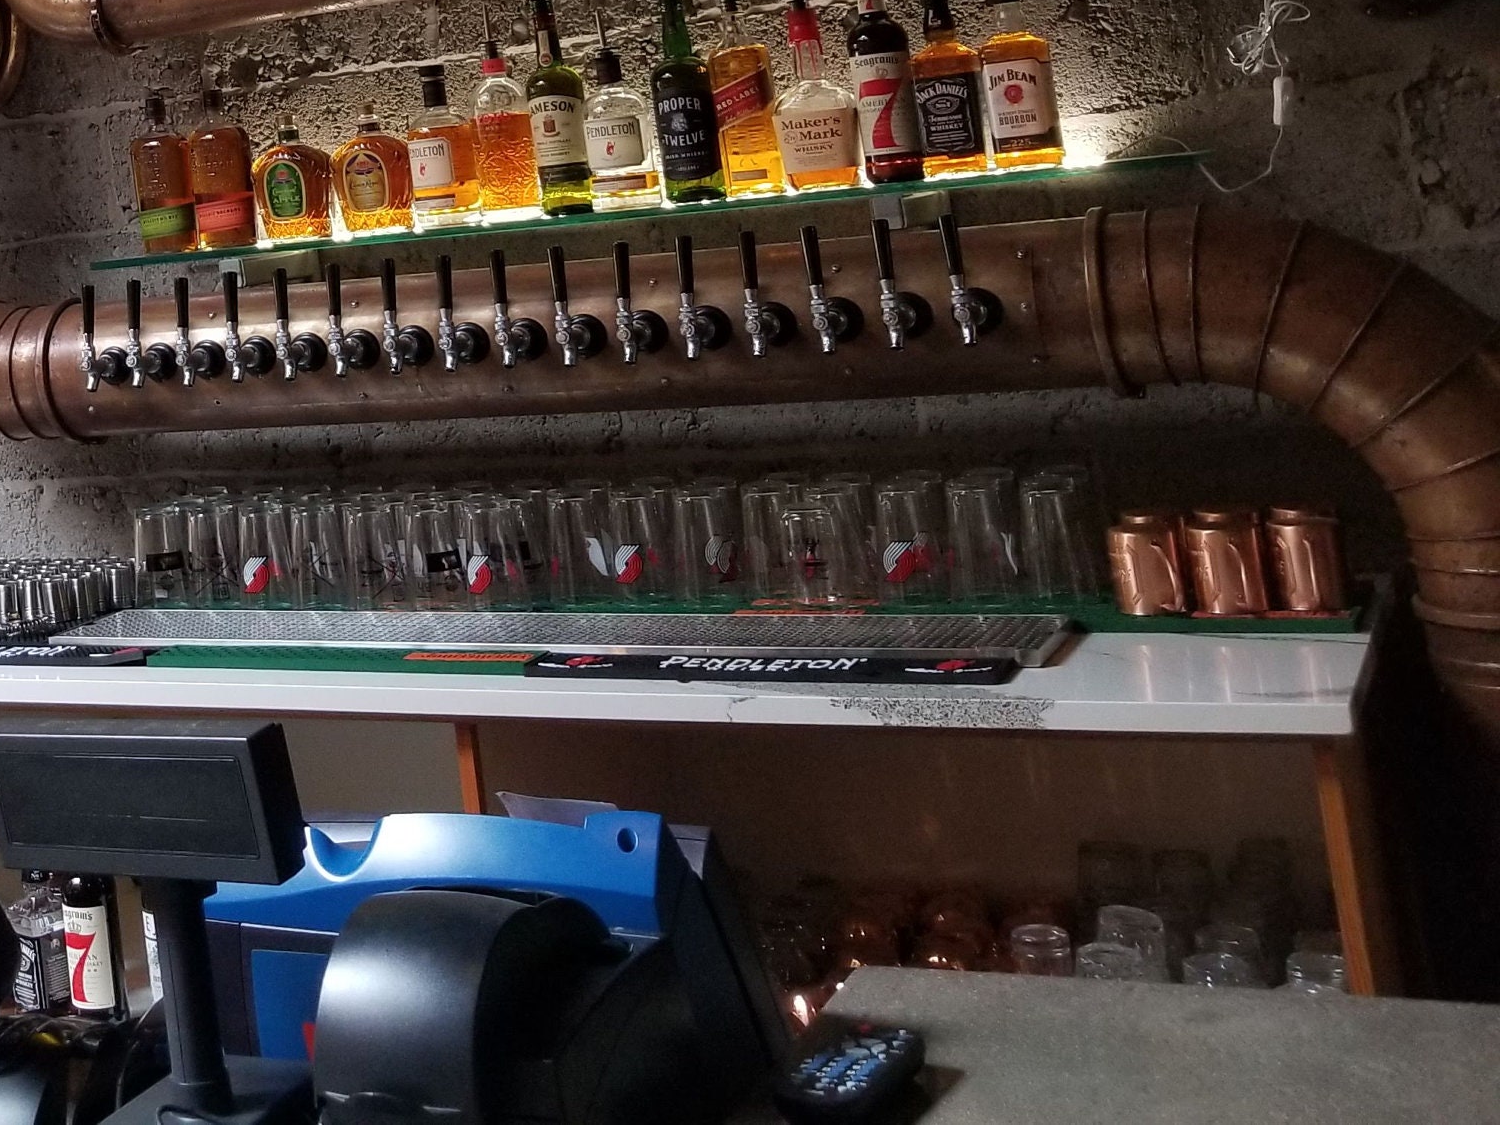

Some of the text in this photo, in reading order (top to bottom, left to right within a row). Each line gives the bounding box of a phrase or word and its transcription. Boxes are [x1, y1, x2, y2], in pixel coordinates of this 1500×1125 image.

[989, 69, 1037, 91] JIM BEAM
[716, 86, 760, 111] RED LABEL
[916, 82, 968, 104] JACK DANIEL'S
[530, 101, 576, 116] AMESON
[658, 97, 701, 115] PROPER
[859, 78, 902, 149] 7
[781, 115, 842, 131] Maker's
[999, 112, 1037, 126] BOURBON
[586, 122, 635, 139] PENDLETON
[799, 127, 842, 141] Mark
[930, 122, 964, 133] WHISKEY
[664, 130, 705, 147] TWELVE
[409, 143, 445, 159] NDLETON
[793, 143, 834, 153] WHISKY
[660, 655, 862, 671] PENDLETON
[65, 931, 97, 1003] 7
